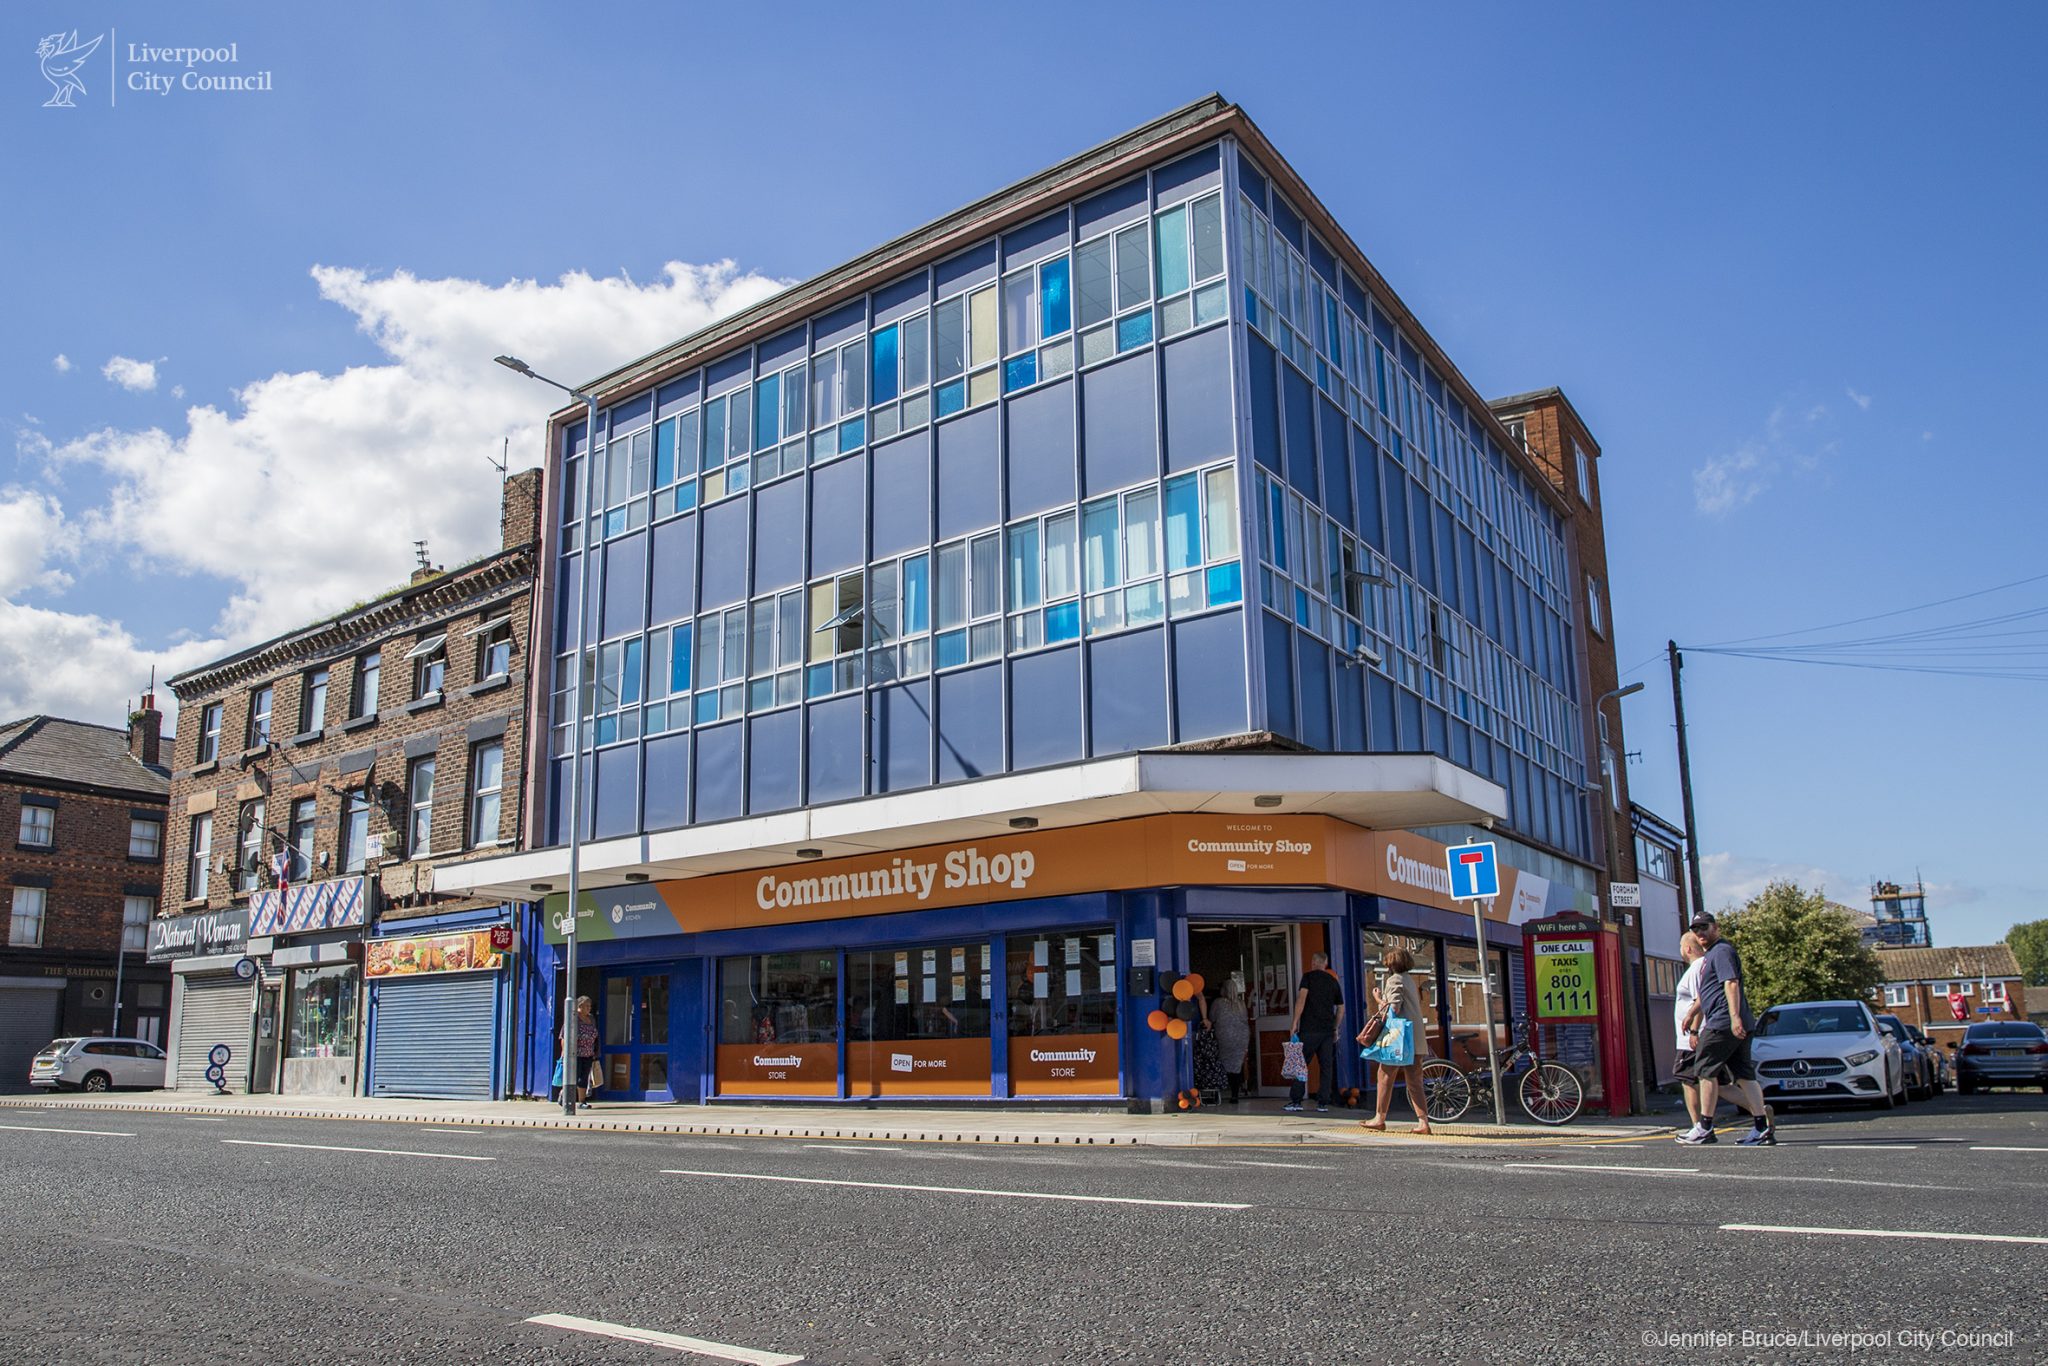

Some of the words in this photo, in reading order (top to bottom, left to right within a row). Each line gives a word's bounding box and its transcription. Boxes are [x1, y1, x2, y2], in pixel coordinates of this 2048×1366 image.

[1187, 839, 1273, 855] Community
[1276, 839, 1312, 855] Shop
[1386, 843, 1452, 898] Commun
[756, 858, 937, 910] Community
[944, 848, 1035, 889] Shop
[1613, 885, 1638, 895] FORDHAM
[1614, 896, 1632, 904] STREET
[625, 901, 657, 912] Community
[1537, 923, 1556, 932] WiFi
[1558, 922, 1577, 931] here
[154, 918, 197, 950] Natural
[197, 915, 241, 943] Woman
[493, 930, 510, 938] JUST
[1541, 944, 1560, 953] ONE
[1561, 943, 1585, 952] CALL
[1551, 957, 1579, 967] TAXIS
[44, 966, 64, 975] THE
[1551, 974, 1581, 989] 800
[1544, 990, 1592, 1011] 1111
[1030, 1048, 1096, 1063] Community
[753, 1055, 802, 1068] Community
[893, 1059, 910, 1067] OPEN
[768, 1071, 786, 1079] STORE
[1051, 1068, 1075, 1077] STORE
